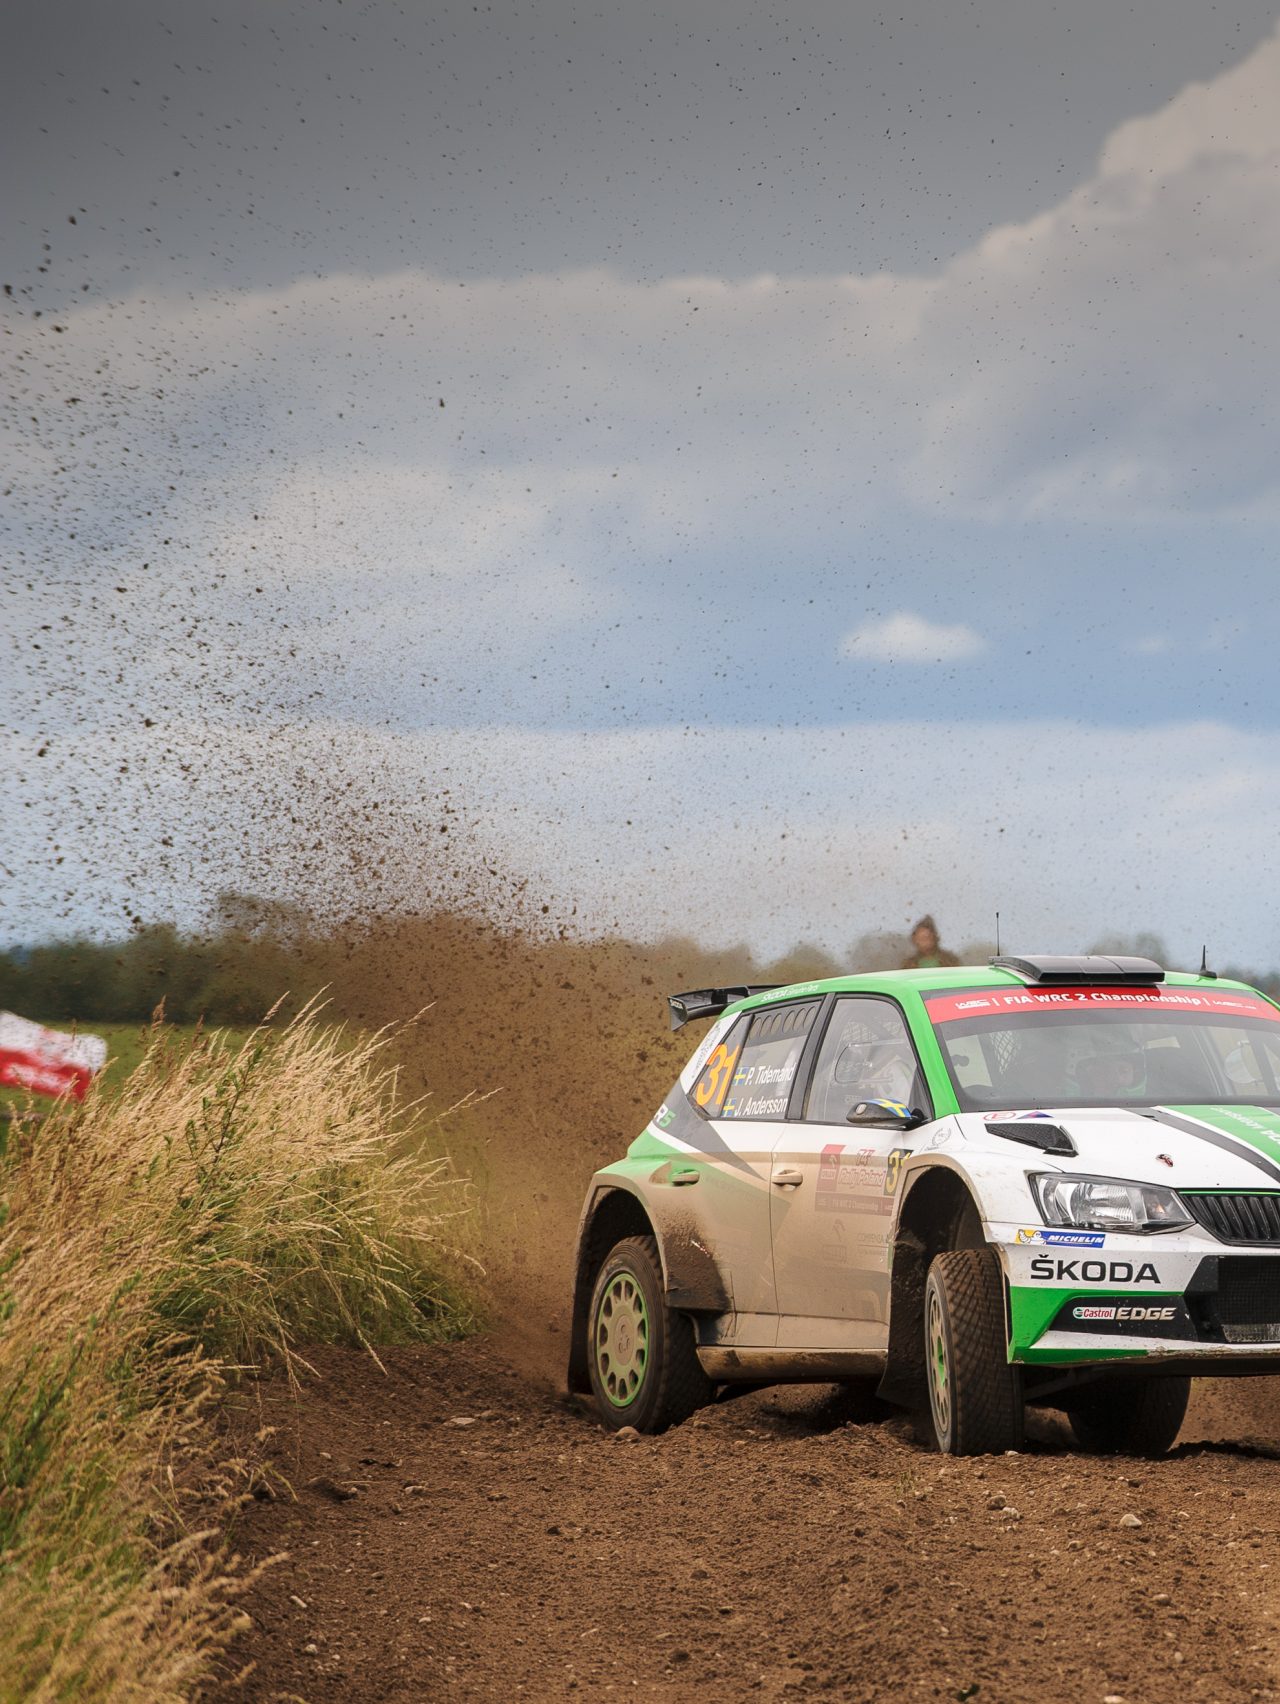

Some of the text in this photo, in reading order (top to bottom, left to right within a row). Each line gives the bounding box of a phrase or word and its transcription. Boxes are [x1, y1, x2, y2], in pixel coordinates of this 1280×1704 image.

[1003, 993, 1201, 1006] FIA WRC 2 Championship
[696, 1043, 740, 1106] 31
[755, 1063, 797, 1085] Tidemand
[743, 1097, 789, 1116] Andersson
[1048, 1235, 1105, 1244] MICHELIN
[1030, 1254, 1161, 1284] ŠKODA
[1083, 1307, 1177, 1321] Castrol EDGE
